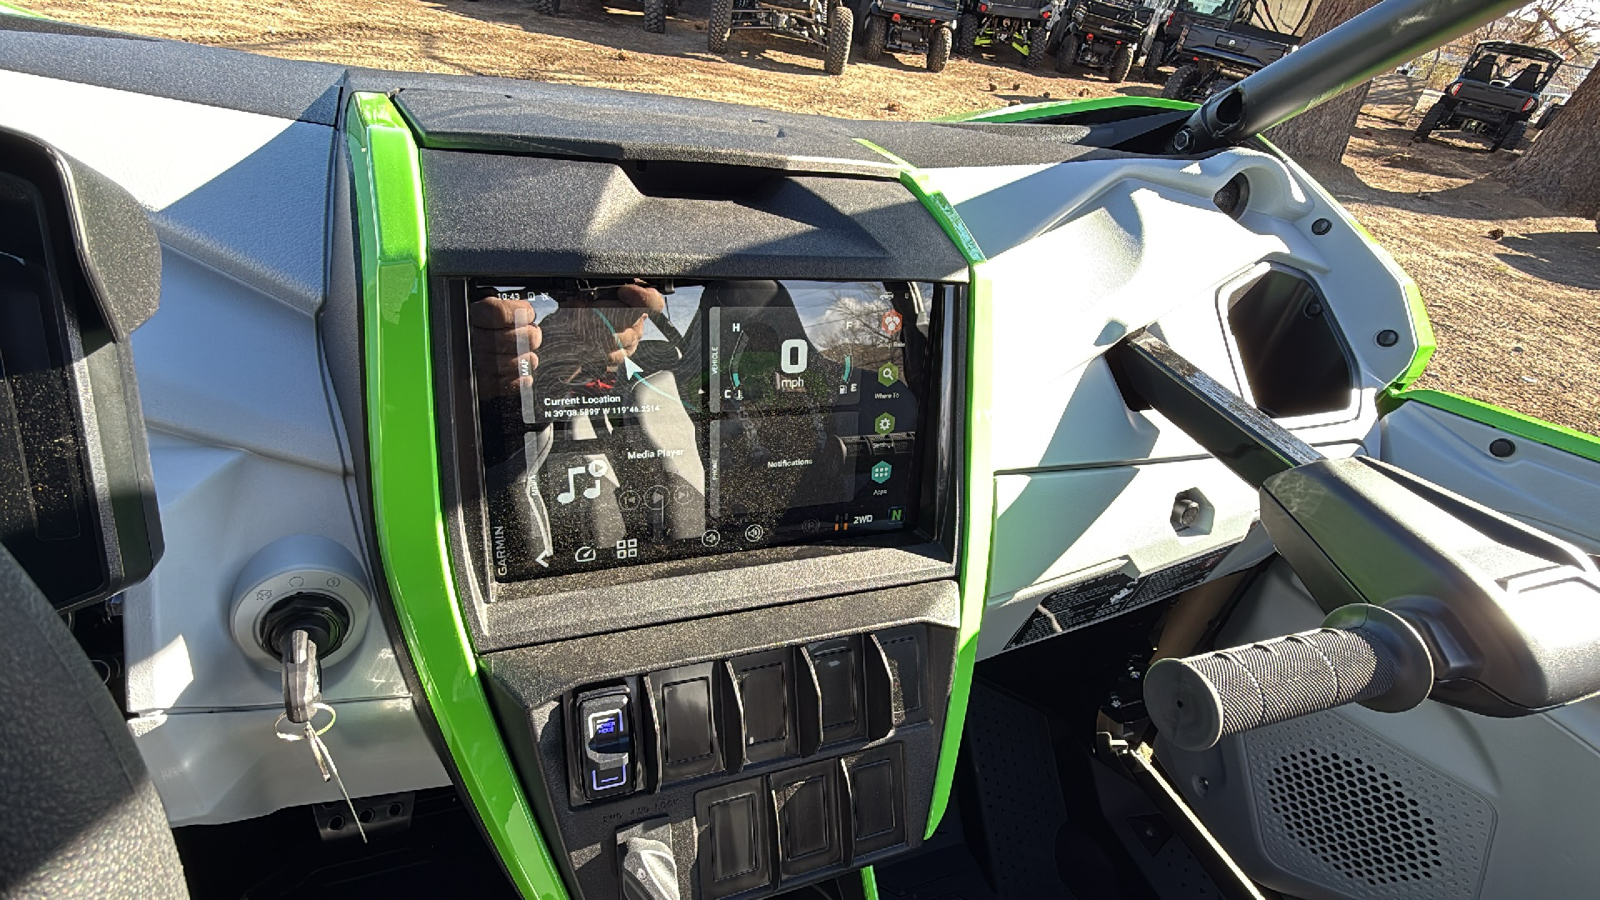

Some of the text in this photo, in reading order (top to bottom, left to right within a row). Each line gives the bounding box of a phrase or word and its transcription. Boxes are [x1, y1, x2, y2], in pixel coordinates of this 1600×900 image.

[497, 292, 520, 300] 10:43
[732, 322, 741, 333] H
[846, 321, 853, 330] F
[711, 346, 719, 375] VEHICLE
[781, 338, 808, 374] 0
[521, 358, 530, 376] MAP
[781, 376, 805, 389] mph
[850, 383, 858, 392] E
[724, 389, 732, 399] C
[544, 394, 621, 406] Current Location
[544, 410, 552, 418] N
[627, 448, 685, 460] Media Player
[766, 458, 813, 468] Notifications
[853, 514, 873, 525] 2WD
[891, 509, 903, 521] N
[494, 525, 508, 576] GARMIN
